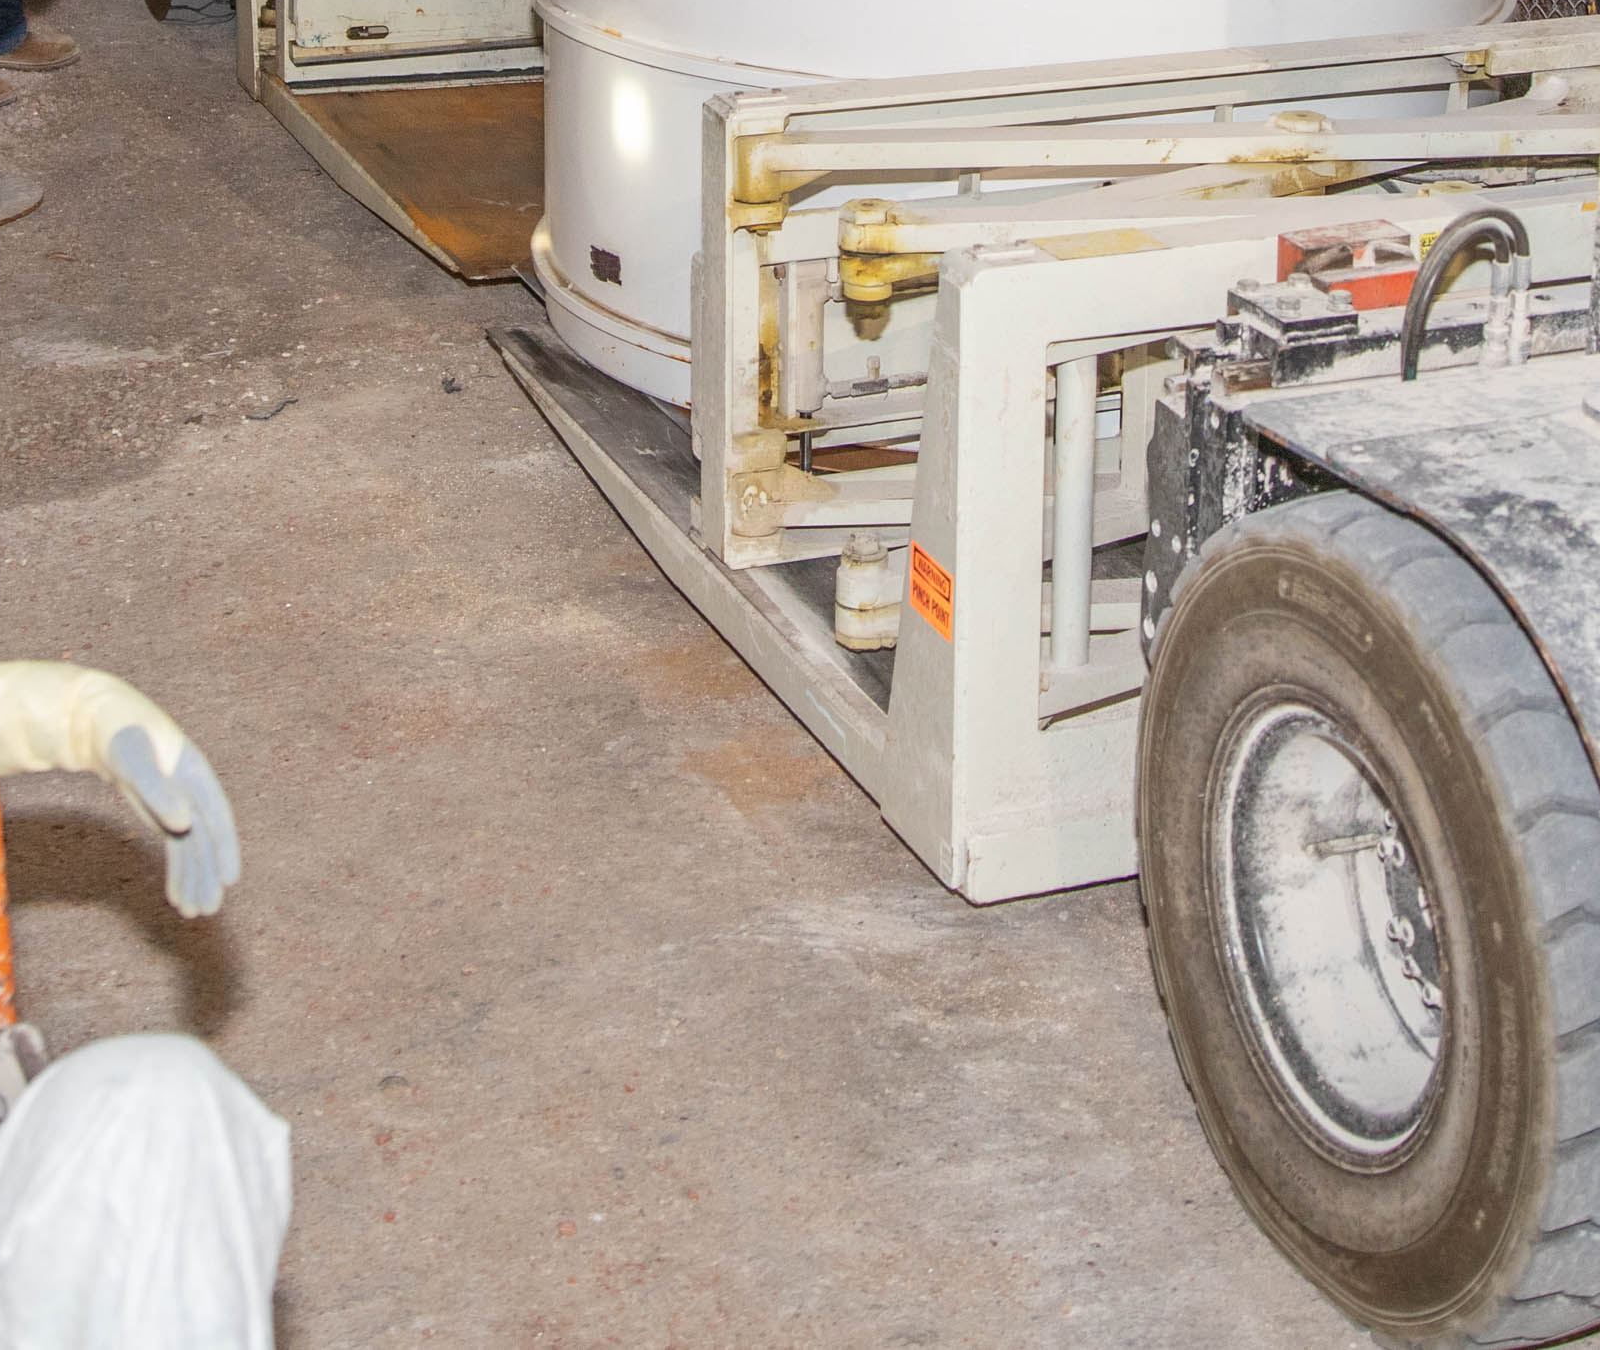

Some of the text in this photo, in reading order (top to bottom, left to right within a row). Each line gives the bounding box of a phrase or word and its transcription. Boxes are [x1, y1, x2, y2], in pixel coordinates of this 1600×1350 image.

[917, 555, 948, 594] WARNING
[912, 579, 949, 628] PINCH POINT
